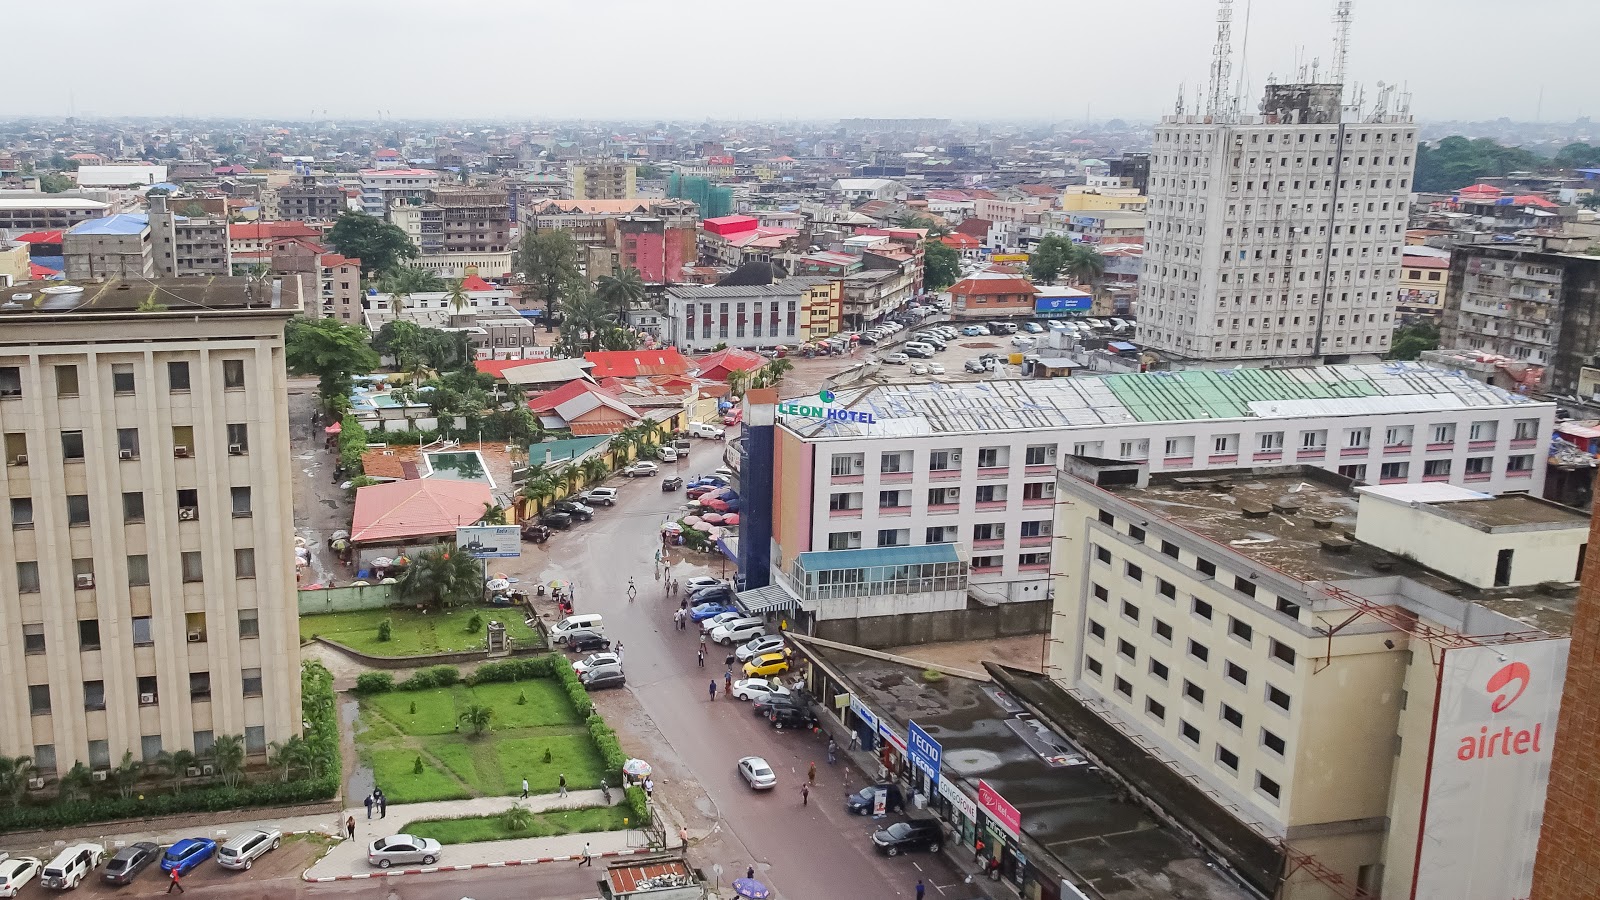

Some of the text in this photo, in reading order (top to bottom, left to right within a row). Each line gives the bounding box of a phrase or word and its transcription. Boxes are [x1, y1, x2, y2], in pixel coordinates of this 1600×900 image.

[778, 403, 877, 424] LEON HOTEL
[911, 730, 939, 762] TECNO
[1457, 722, 1542, 761] airtel
[911, 751, 935, 779] TECNO
[940, 781, 975, 818] CONGOFONE
[985, 816, 1008, 841] Infinix
